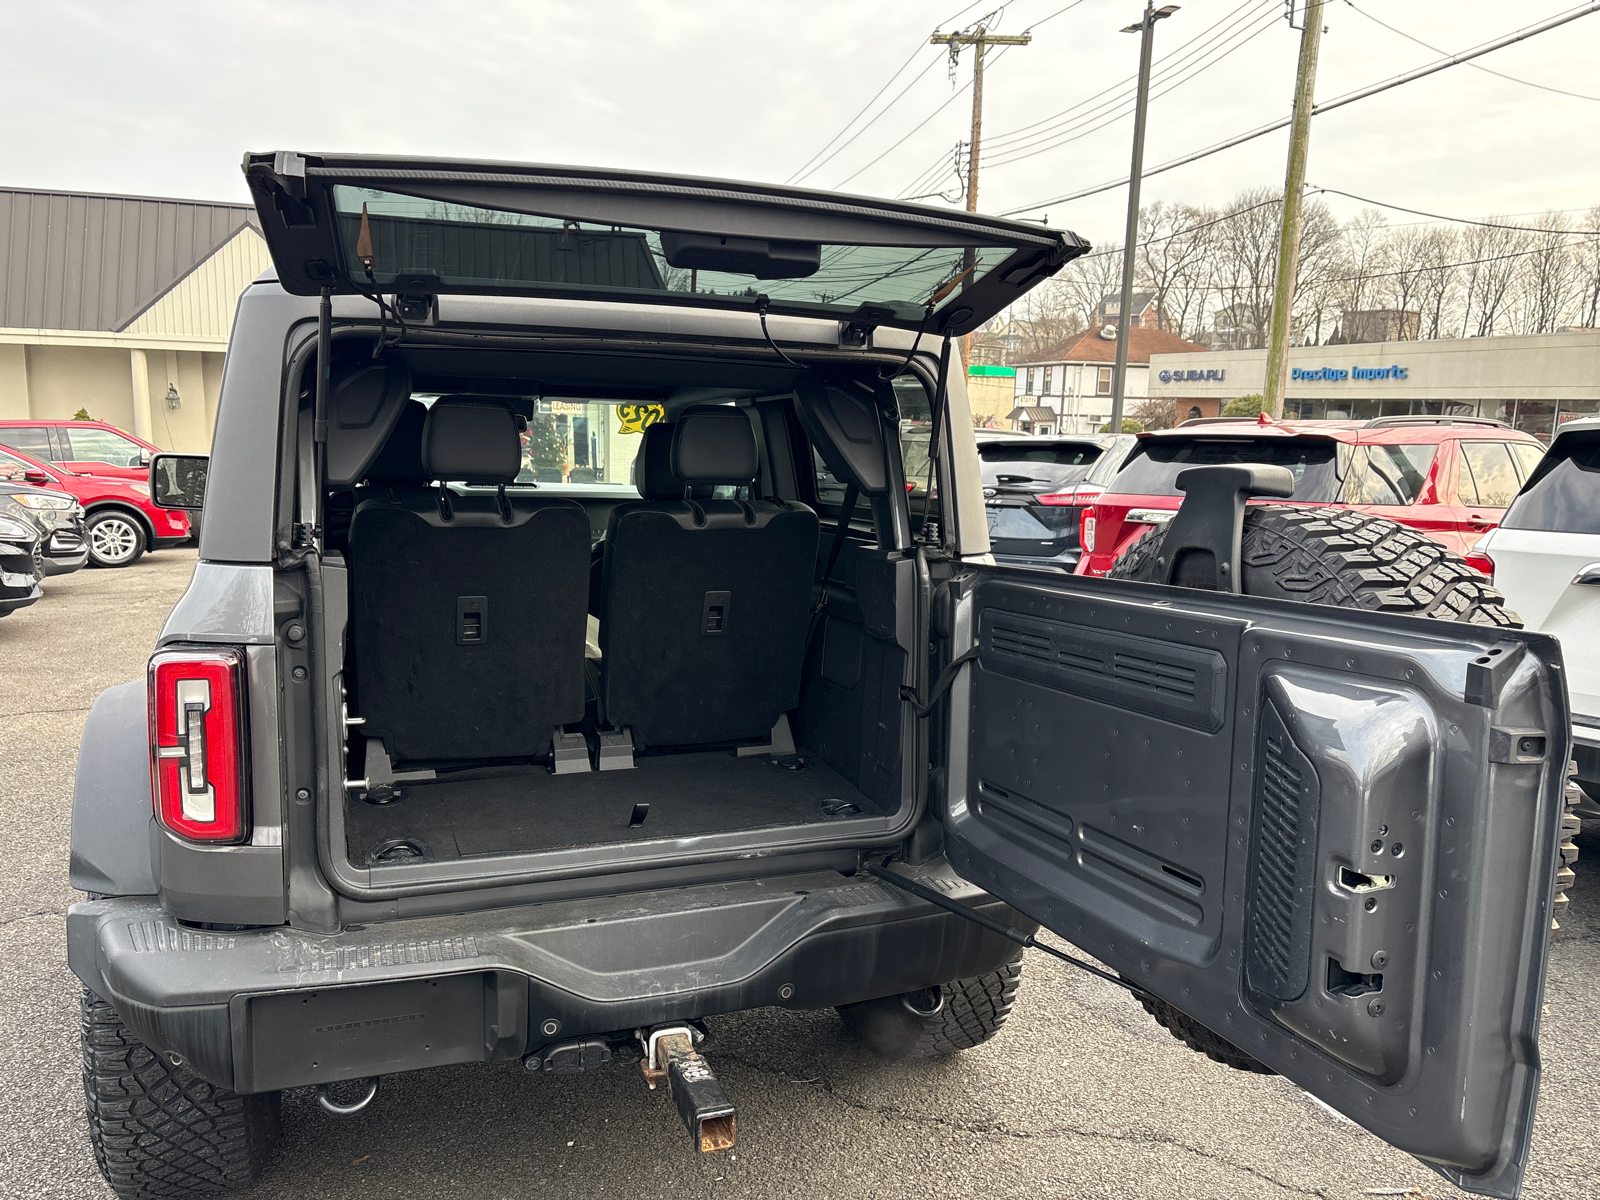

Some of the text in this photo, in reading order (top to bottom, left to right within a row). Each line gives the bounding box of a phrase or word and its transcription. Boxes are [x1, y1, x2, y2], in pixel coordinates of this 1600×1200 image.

[1173, 369, 1226, 382] SUBARU
[1291, 365, 1408, 381] Prestige Imports
[552, 402, 582, 411] LEASING
[315, 1012, 426, 1033] BRONCO
